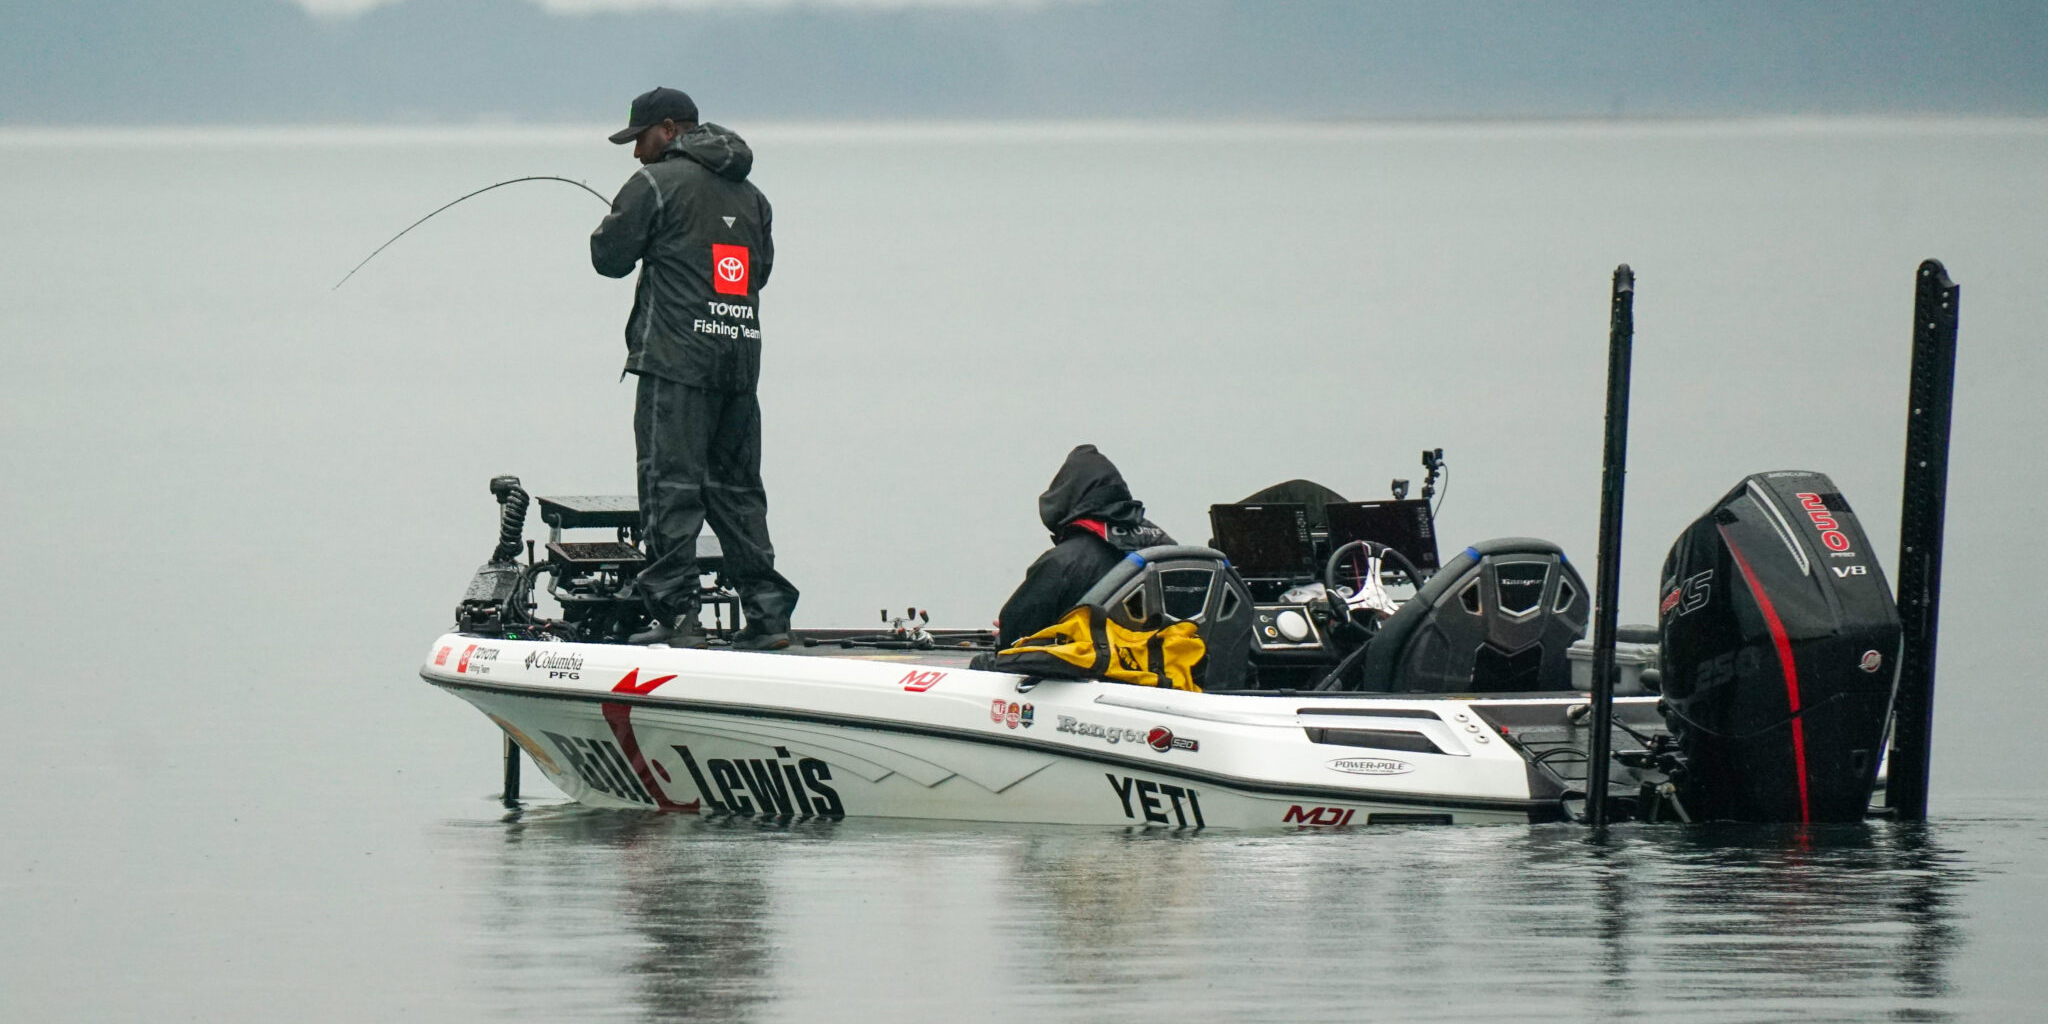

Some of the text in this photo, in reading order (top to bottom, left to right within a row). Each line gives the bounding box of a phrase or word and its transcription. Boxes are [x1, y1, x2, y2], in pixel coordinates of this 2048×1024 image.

[708, 301, 754, 319] TOYOTA
[693, 319, 761, 339] Fishing Team
[1796, 492, 1850, 552] 250
[1832, 565, 1867, 578] V8
[535, 651, 584, 671] Columbia
[549, 671, 580, 680] PFG
[1056, 714, 1147, 744] Ranger
[1334, 760, 1404, 771] POWER-POLE
[671, 745, 846, 816] Lewis
[1105, 773, 1205, 828] YETI
